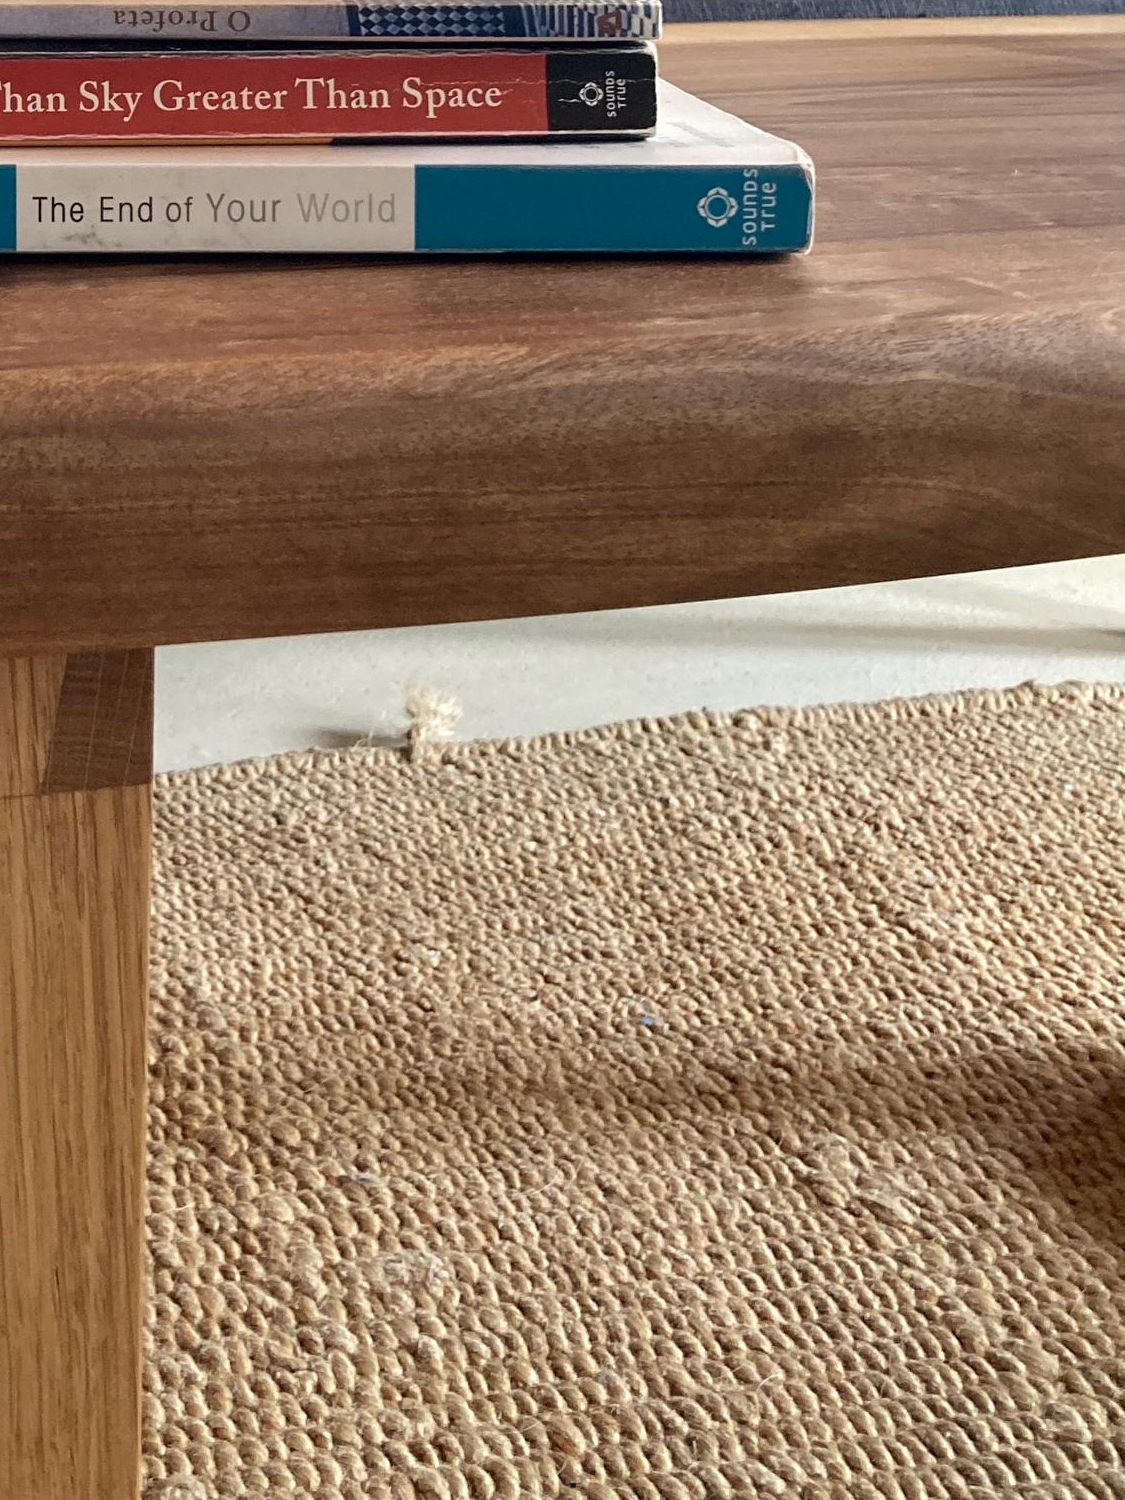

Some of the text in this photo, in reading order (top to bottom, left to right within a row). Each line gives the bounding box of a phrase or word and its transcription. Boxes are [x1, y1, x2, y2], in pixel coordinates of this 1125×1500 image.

[113, 10, 251, 33] O Profeta
[78, 80, 144, 122] Sky
[153, 79, 287, 112] Greater
[294, 77, 391, 110] Than
[401, 76, 503, 119] Space
[32, 192, 396, 223] The End of Your World
